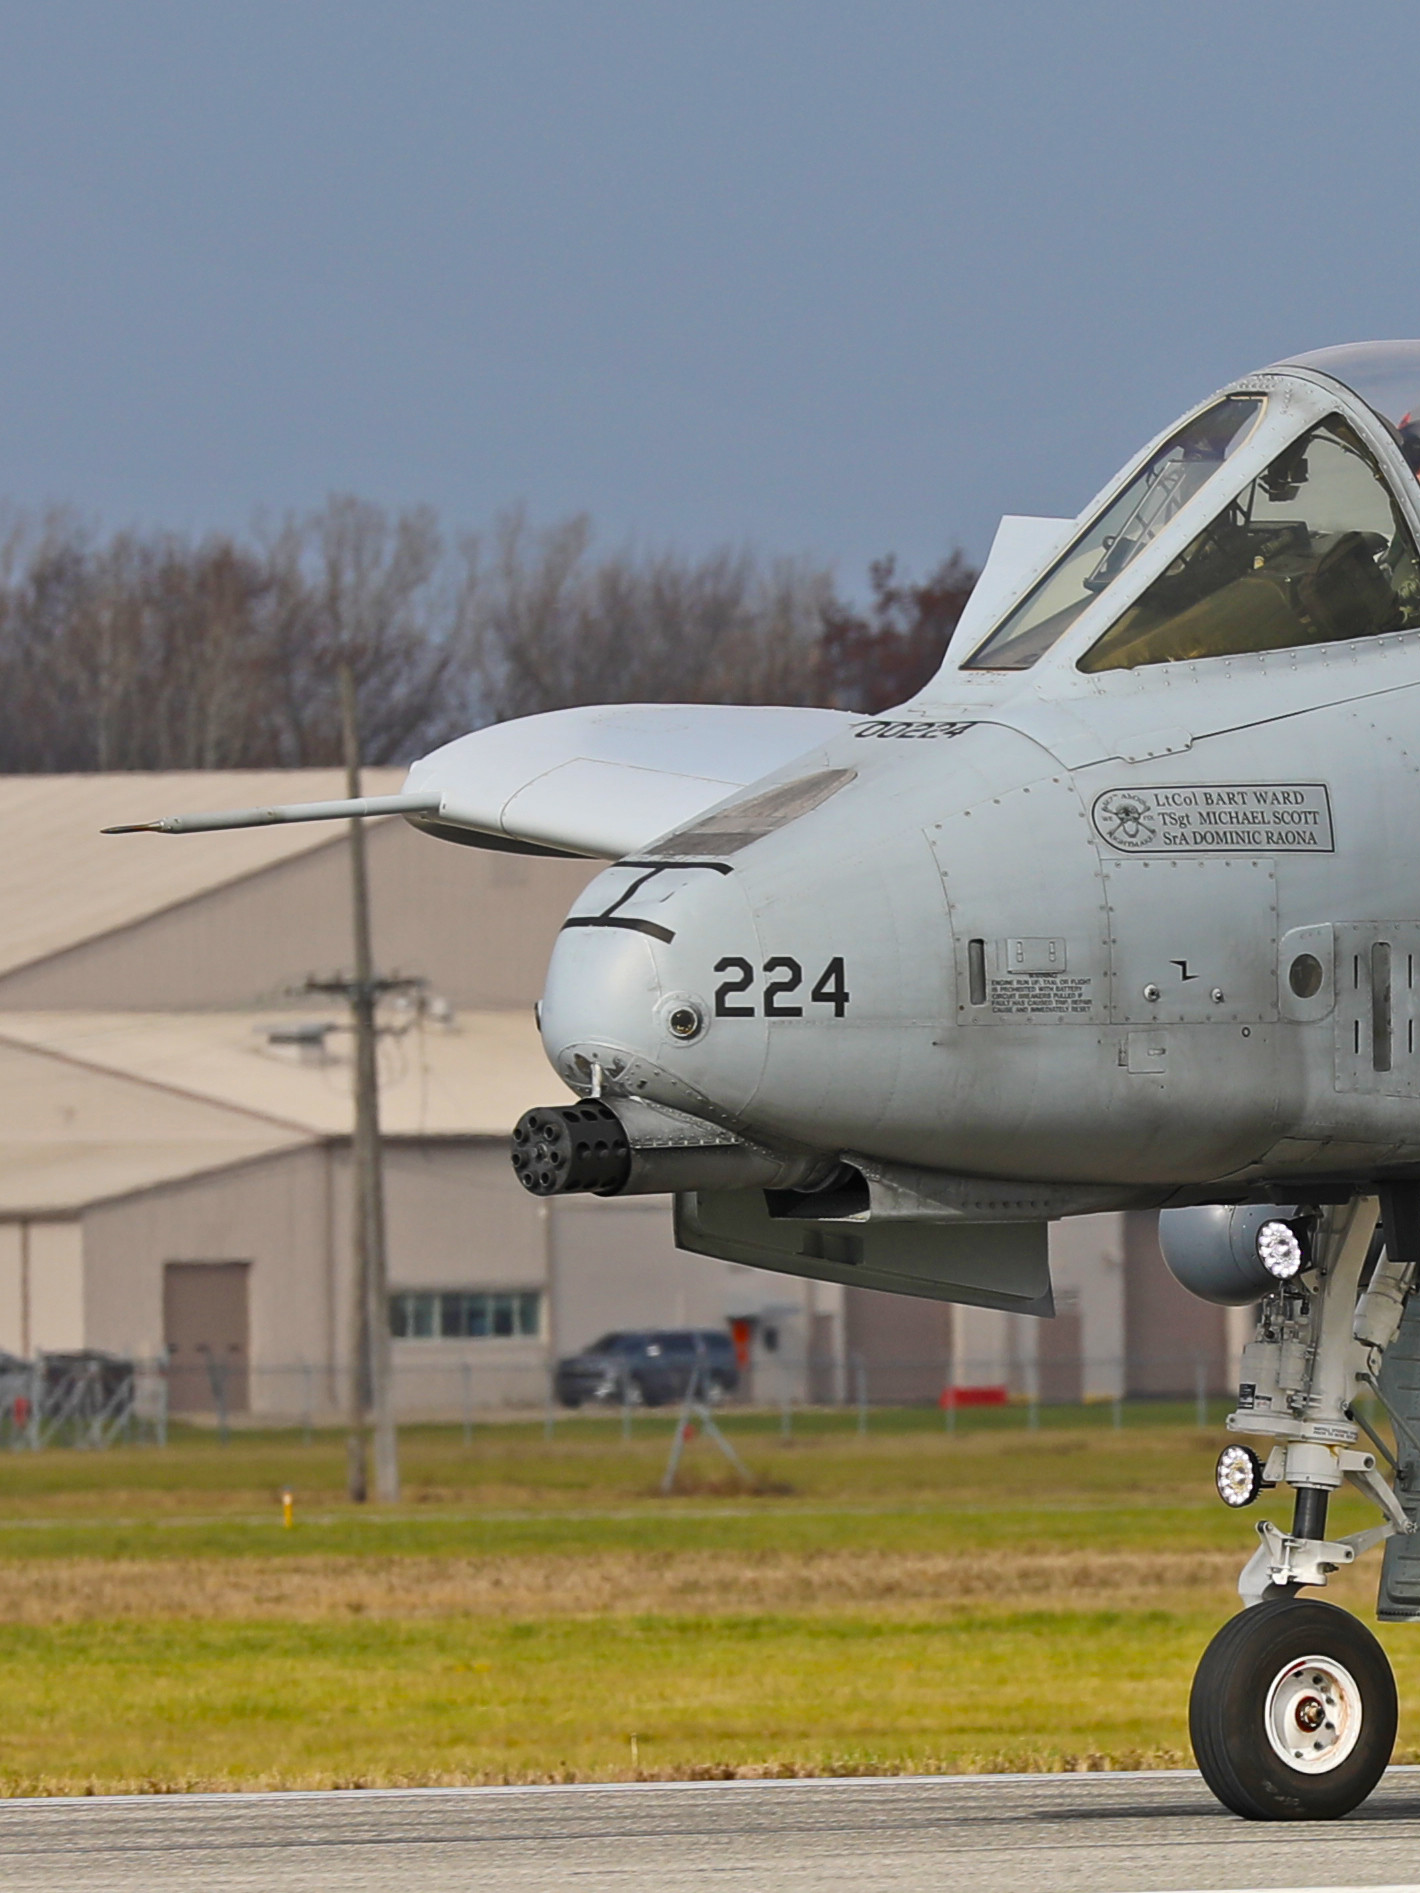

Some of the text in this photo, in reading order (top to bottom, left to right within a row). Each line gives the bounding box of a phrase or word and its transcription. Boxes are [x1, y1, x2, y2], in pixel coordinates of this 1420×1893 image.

[854, 720, 978, 739] 00224
[1154, 791, 1199, 807] LtCol
[1203, 791, 1248, 806] BART
[1252, 790, 1305, 805] WARD
[1157, 810, 1320, 829] TSgt MICHAEL SCOTT
[1163, 831, 1319, 846] SrA DOMINIC RAONA
[713, 956, 850, 1018] 224
